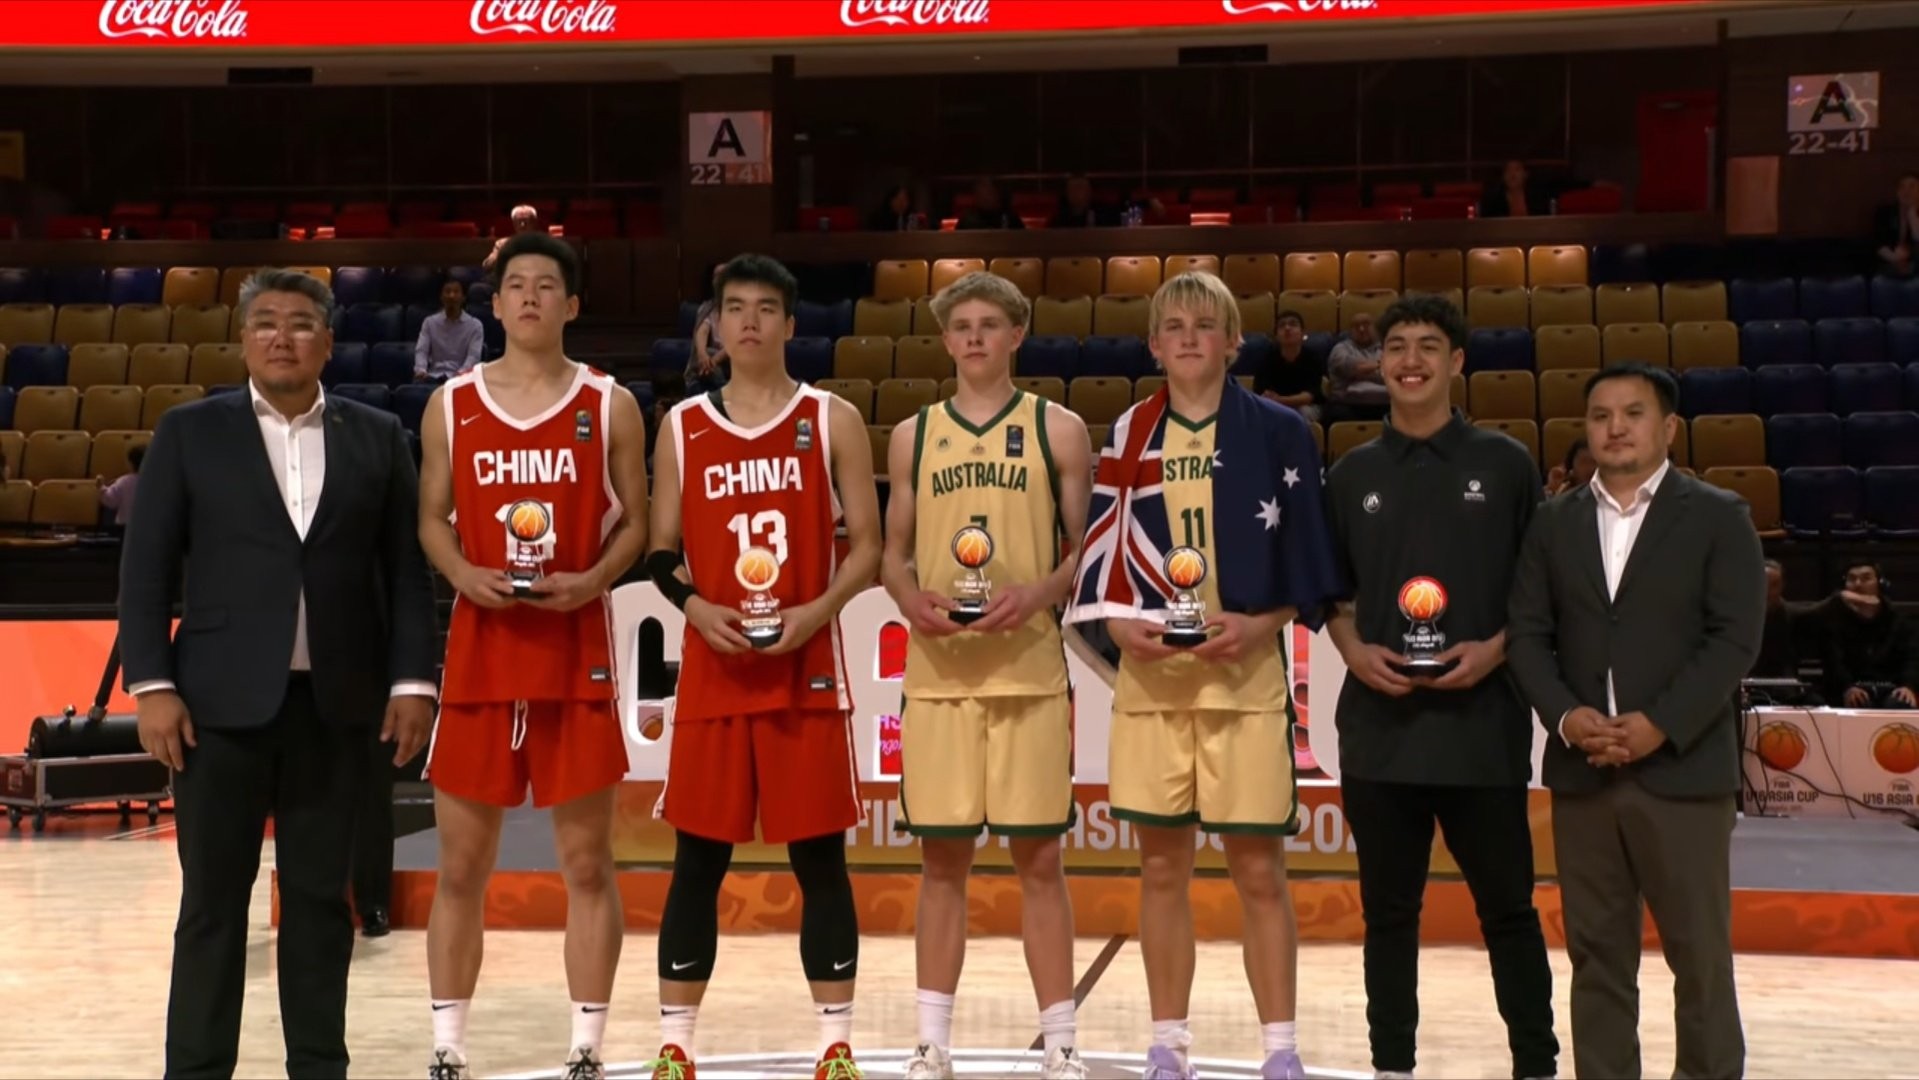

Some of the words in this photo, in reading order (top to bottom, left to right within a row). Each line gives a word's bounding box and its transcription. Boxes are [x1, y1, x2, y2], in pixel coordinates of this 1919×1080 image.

[1810, 81, 1854, 124] A
[708, 118, 746, 158] A
[1789, 131, 1869, 154] 22-41
[690, 165, 763, 185] 22-41
[473, 448, 578, 486] CHINA
[704, 456, 803, 500] CHINA
[931, 461, 1028, 499] AUSTRALIA
[726, 509, 788, 567] 13
[1181, 507, 1206, 548] 11
[1766, 791, 1794, 802] ASIA
[1796, 791, 1819, 803] CUP
[1863, 793, 1885, 805] U16
[1886, 793, 1914, 806] ASIA
